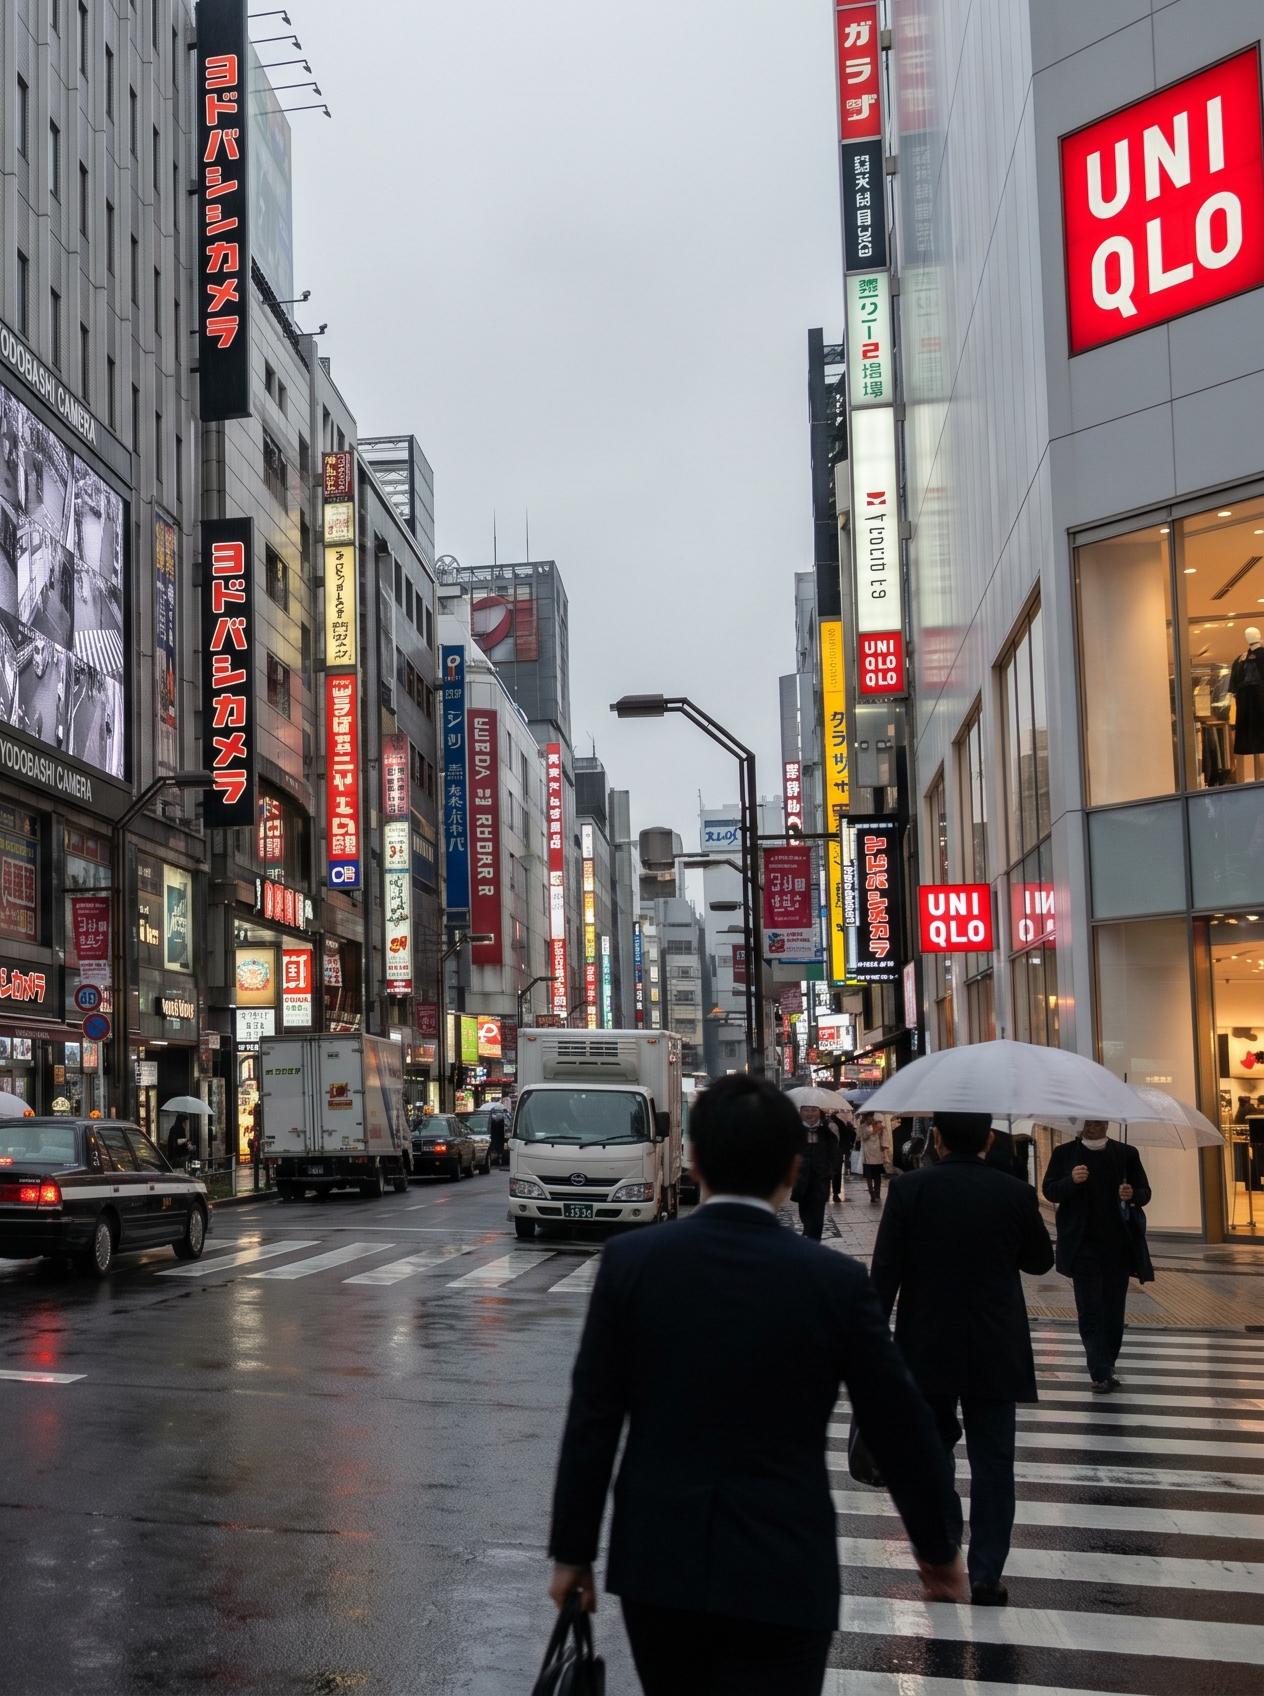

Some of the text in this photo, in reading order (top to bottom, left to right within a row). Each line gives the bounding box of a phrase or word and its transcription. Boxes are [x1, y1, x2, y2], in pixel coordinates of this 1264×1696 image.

[1086, 95, 1225, 219] UNI
[1091, 191, 1243, 319] QLO
[57, 397, 97, 445] CAMERA
[864, 640, 895, 653] UNI
[864, 656, 897, 670] QLO
[210, 541, 248, 804] ヨドバシカメラ
[865, 671, 898, 686] QLO
[0, 738, 93, 802] YODOBASHI CAMERA
[928, 892, 979, 916] UNI
[929, 920, 985, 947] QLO
